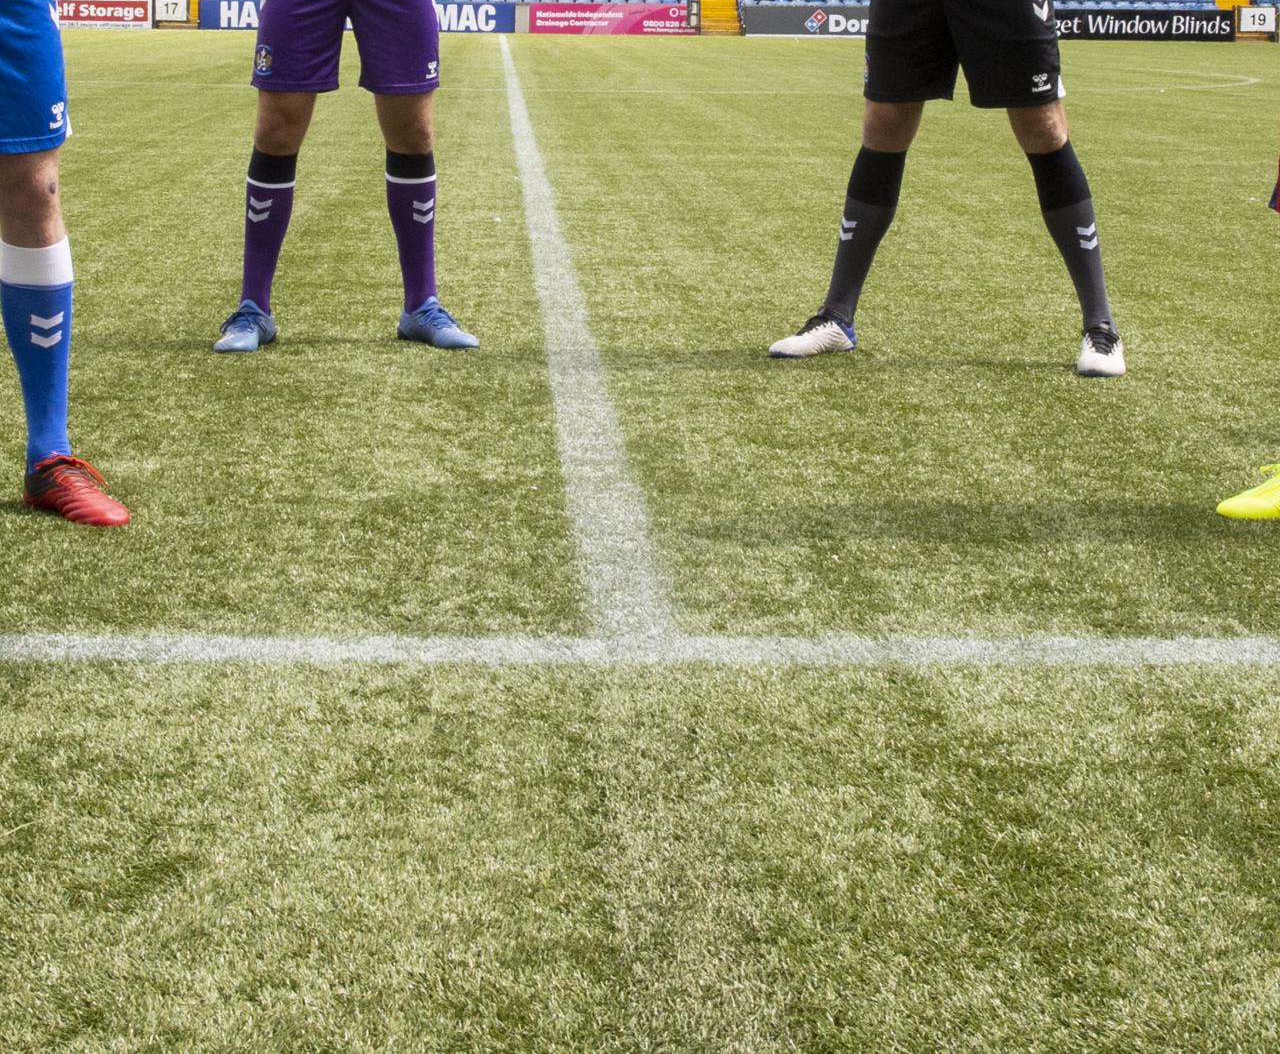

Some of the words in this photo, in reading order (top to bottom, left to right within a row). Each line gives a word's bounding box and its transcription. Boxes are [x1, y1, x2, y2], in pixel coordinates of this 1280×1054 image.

[78, 3, 145, 22] Storage
[163, 2, 178, 15] 17
[535, 11, 577, 19] Nationwide
[577, 11, 624, 20] Independent
[1250, 13, 1266, 26] 19
[535, 20, 569, 28] Drainage
[1087, 15, 1170, 34] Window
[1171, 15, 1231, 35] Blinds
